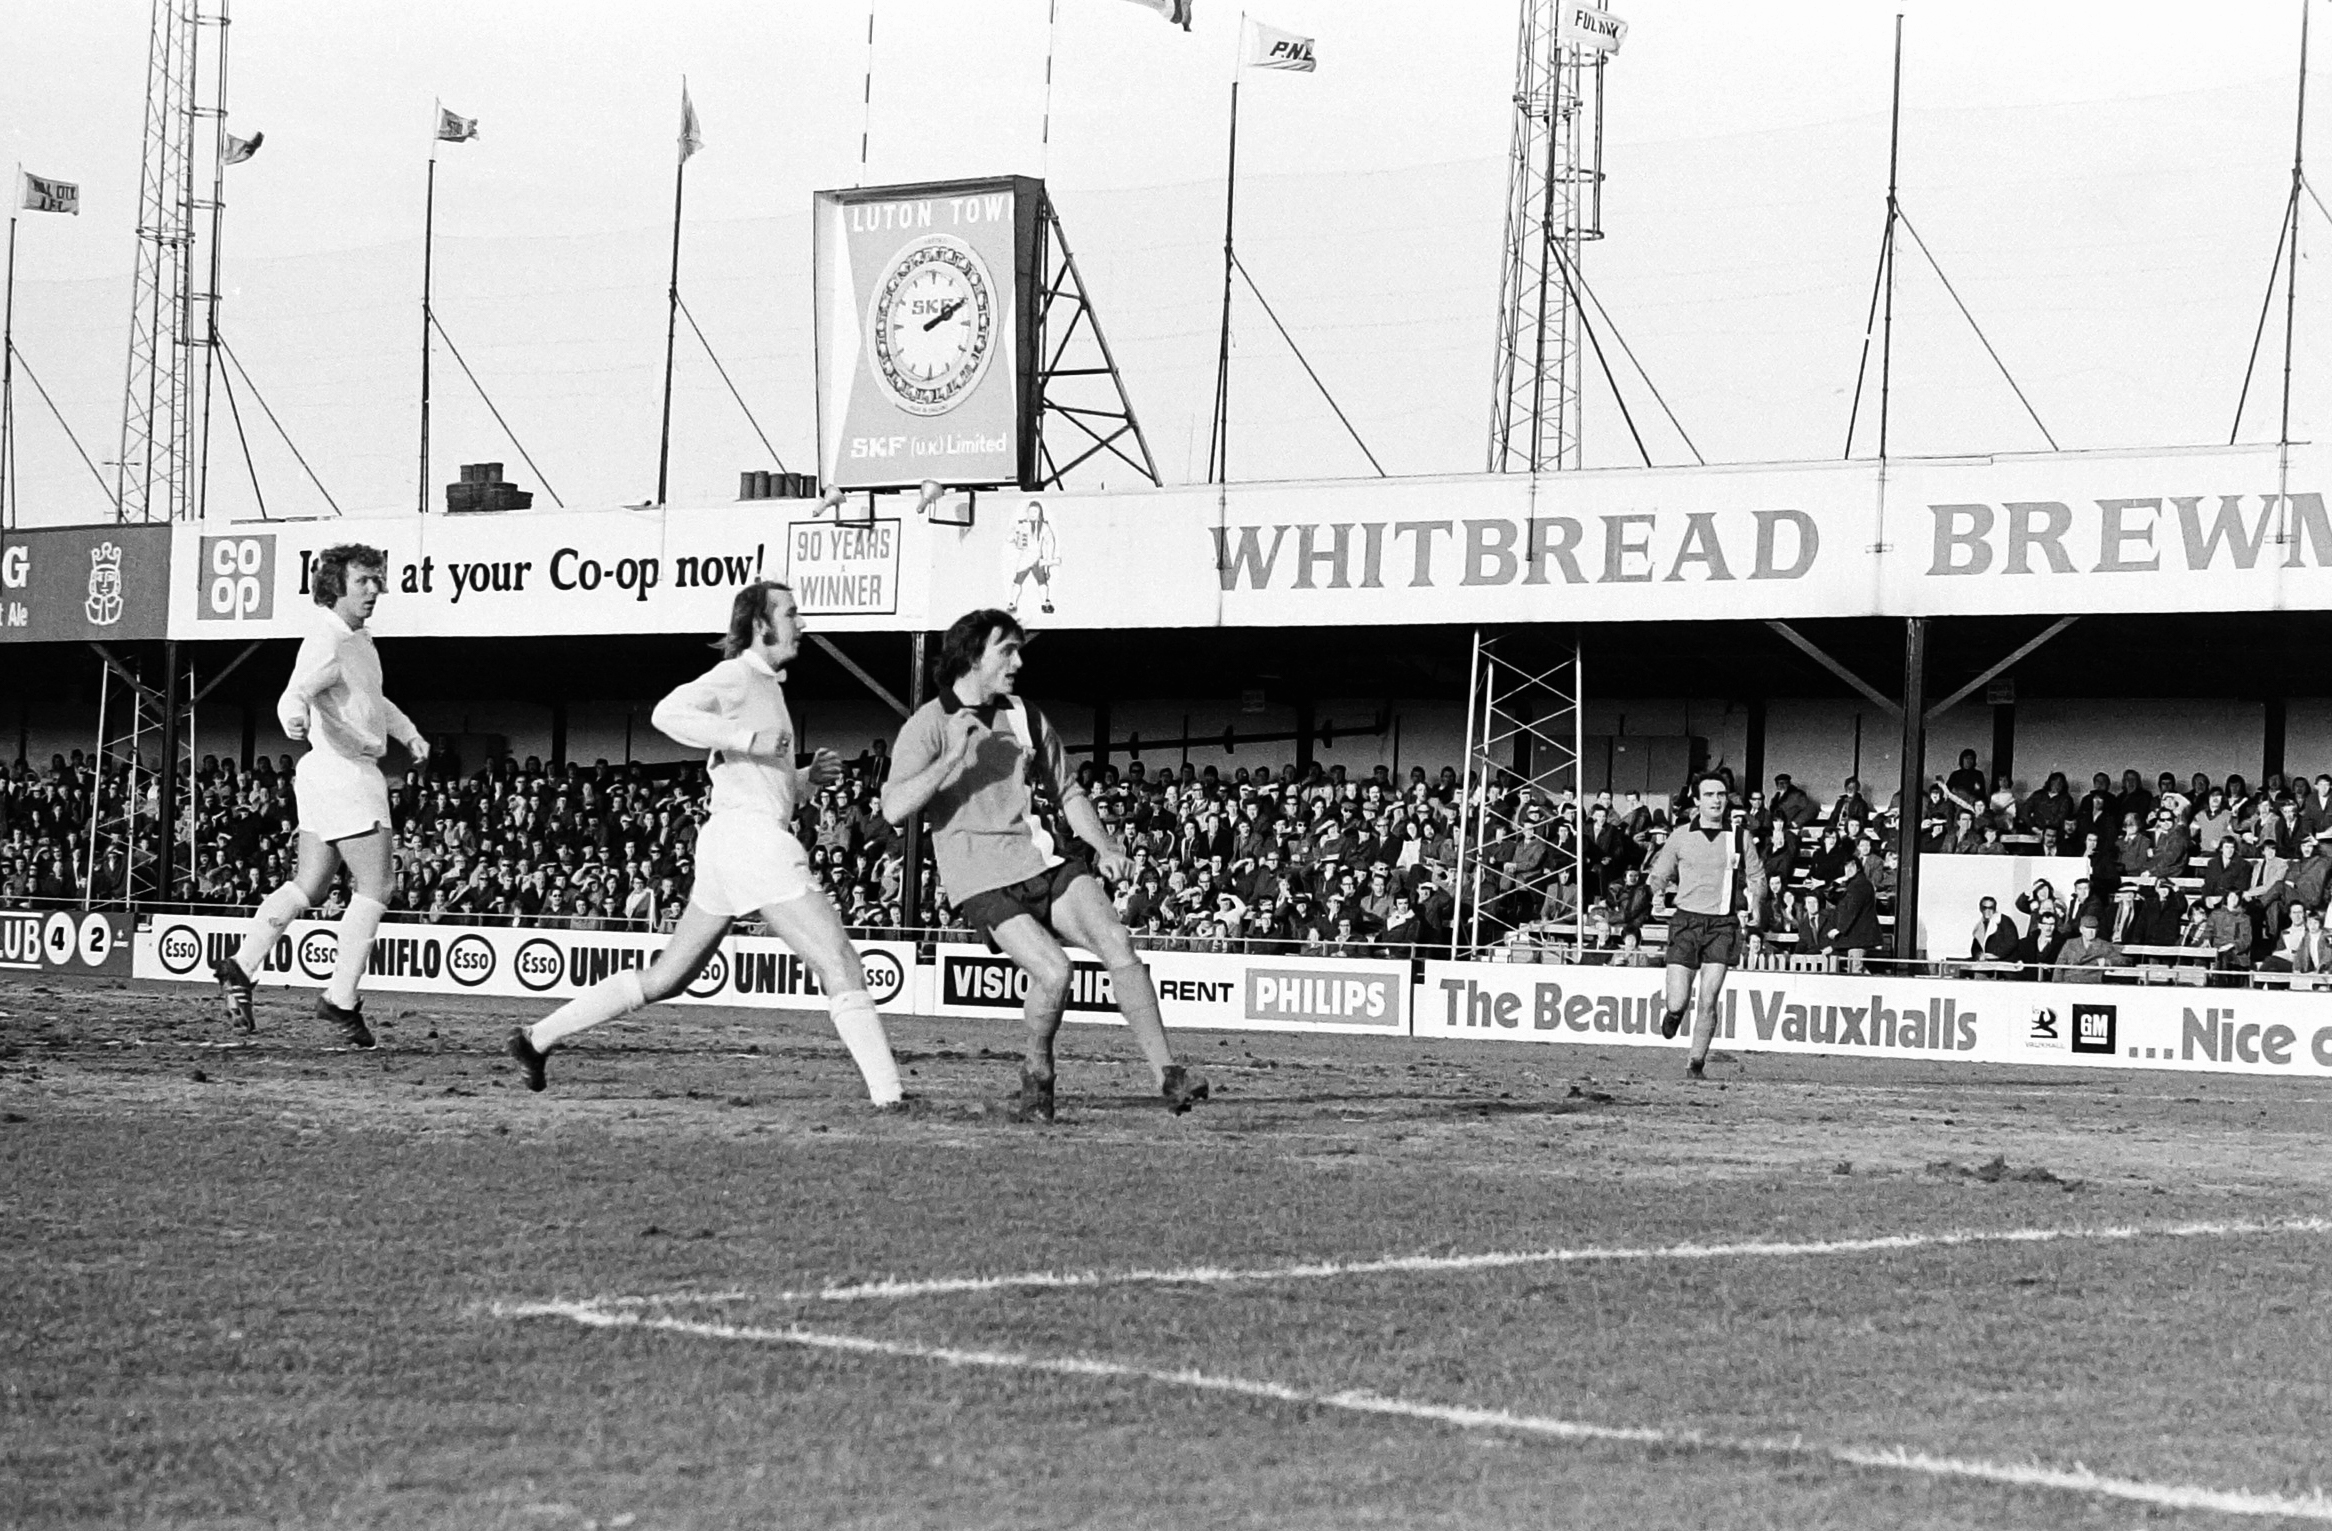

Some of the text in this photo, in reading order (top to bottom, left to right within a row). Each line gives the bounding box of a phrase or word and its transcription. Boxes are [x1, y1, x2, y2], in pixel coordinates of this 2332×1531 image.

[853, 201, 932, 232] LUTON
[851, 436, 907, 458] SKF
[947, 432, 1007, 454] Limited
[797, 529, 891, 561] 90 YEARS
[1208, 509, 1820, 591] WHITBREAD
[401, 556, 434, 593] at
[448, 562, 532, 603] your
[550, 548, 659, 601] Co-op
[675, 543, 765, 587] now!
[800, 574, 882, 607] WINNER
[8, 602, 28, 626] Ale
[0, 920, 42, 962] UB
[368, 938, 441, 978] NIFLO
[735, 952, 828, 995] UNIFL
[1160, 980, 1234, 1003] RENT
[1256, 977, 1386, 1018] PHILIPS
[1440, 979, 1519, 1028] The
[1749, 990, 1976, 1051] Vauxhalls
[2081, 1014, 2108, 1037] GM
